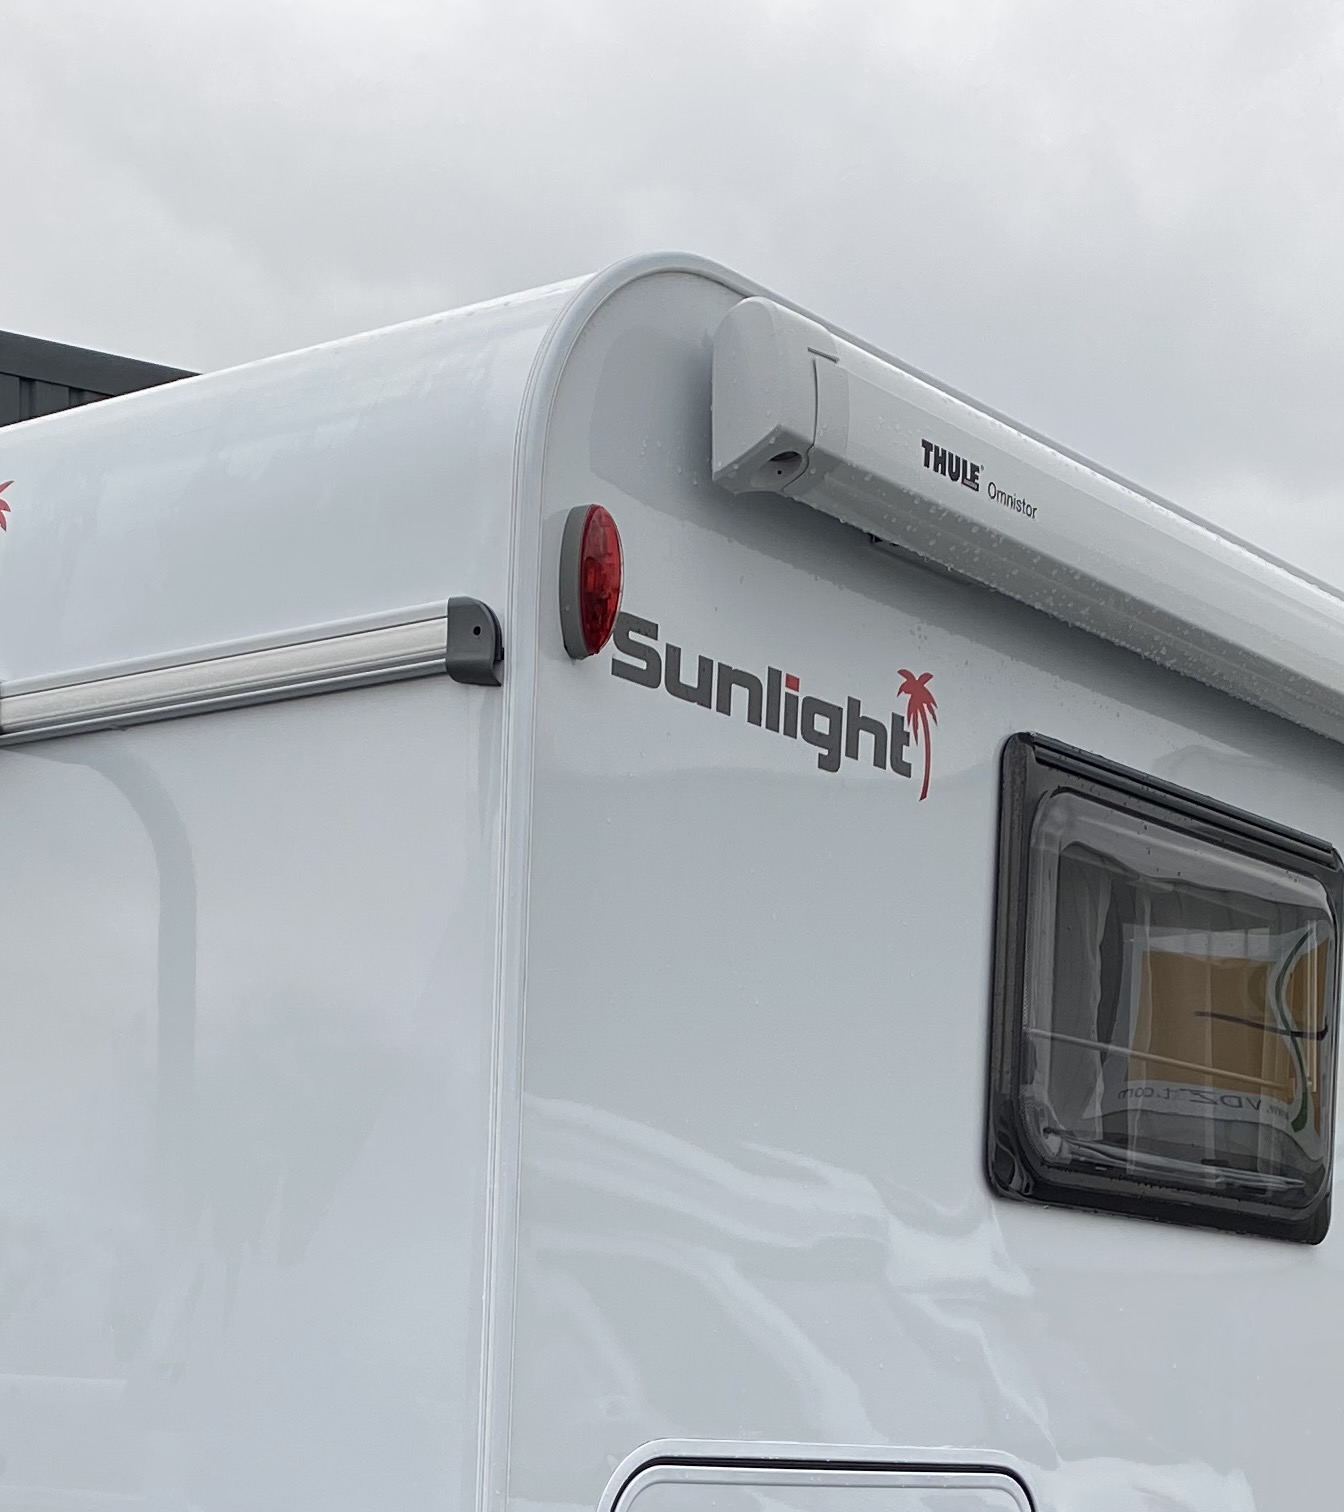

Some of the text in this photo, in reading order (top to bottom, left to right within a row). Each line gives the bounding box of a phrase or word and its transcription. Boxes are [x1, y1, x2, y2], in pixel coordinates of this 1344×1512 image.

[921, 438, 1038, 519] THULE Omnistor
[611, 611, 913, 779] Sunlight
